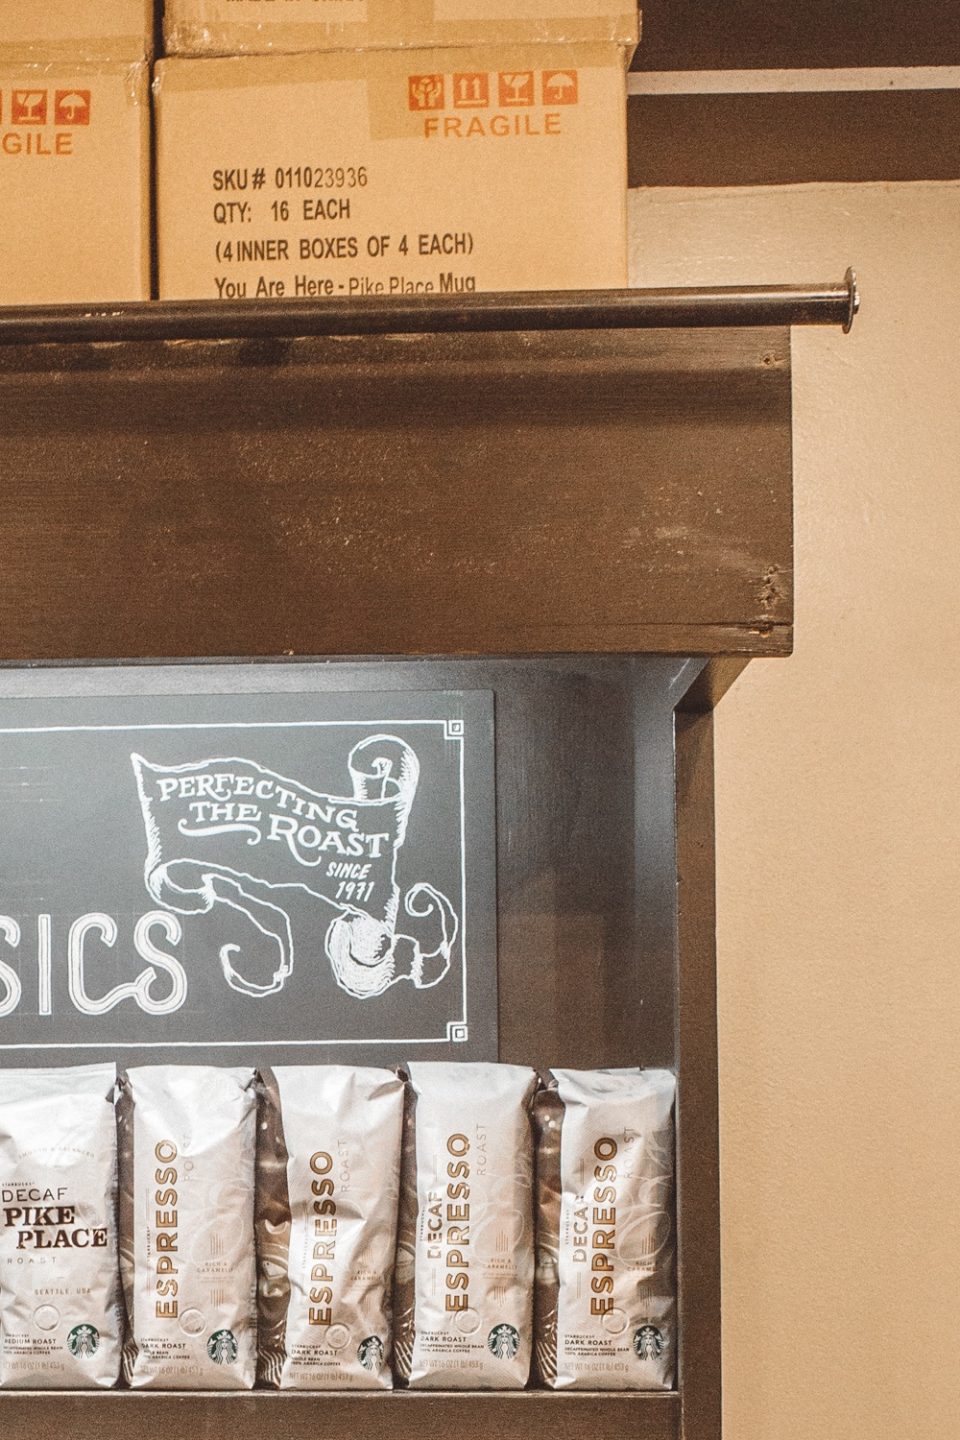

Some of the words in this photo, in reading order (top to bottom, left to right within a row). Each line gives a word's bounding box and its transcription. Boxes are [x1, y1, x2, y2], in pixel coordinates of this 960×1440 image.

[424, 113, 562, 138] FRAGILE
[275, 167, 367, 189] 011023936
[214, 202, 251, 224] QTY:
[271, 200, 288, 221] 16
[304, 198, 350, 220] EACH
[300, 237, 357, 259] BOXES
[367, 236, 390, 256] OF
[398, 235, 408, 256] 4
[419, 232, 473, 255] EACH)
[214, 277, 246, 299] You
[256, 276, 285, 297] Are
[295, 275, 333, 296] Here
[349, 277, 384, 295] Pike
[390, 276, 433, 294] Place
[156, 773, 359, 832] PERFECTING
[189, 801, 261, 823] THE
[267, 814, 389, 866] ROAST
[326, 862, 372, 879] SINCE
[335, 881, 375, 902] 1971
[476, 1123, 486, 1176] ROAST
[1, 1187, 68, 1203] DECAF
[3, 1205, 75, 1227] PIKE
[445, 1133, 470, 1312] ESPRESSO
[590, 1136, 618, 1316] ESPRESSO
[16, 1228, 108, 1250] PLACE
[154, 1139, 178, 1319] ESPRESSO
[308, 1151, 338, 1326] ESPRESSO
[587, 1339, 612, 1347] ROAST
